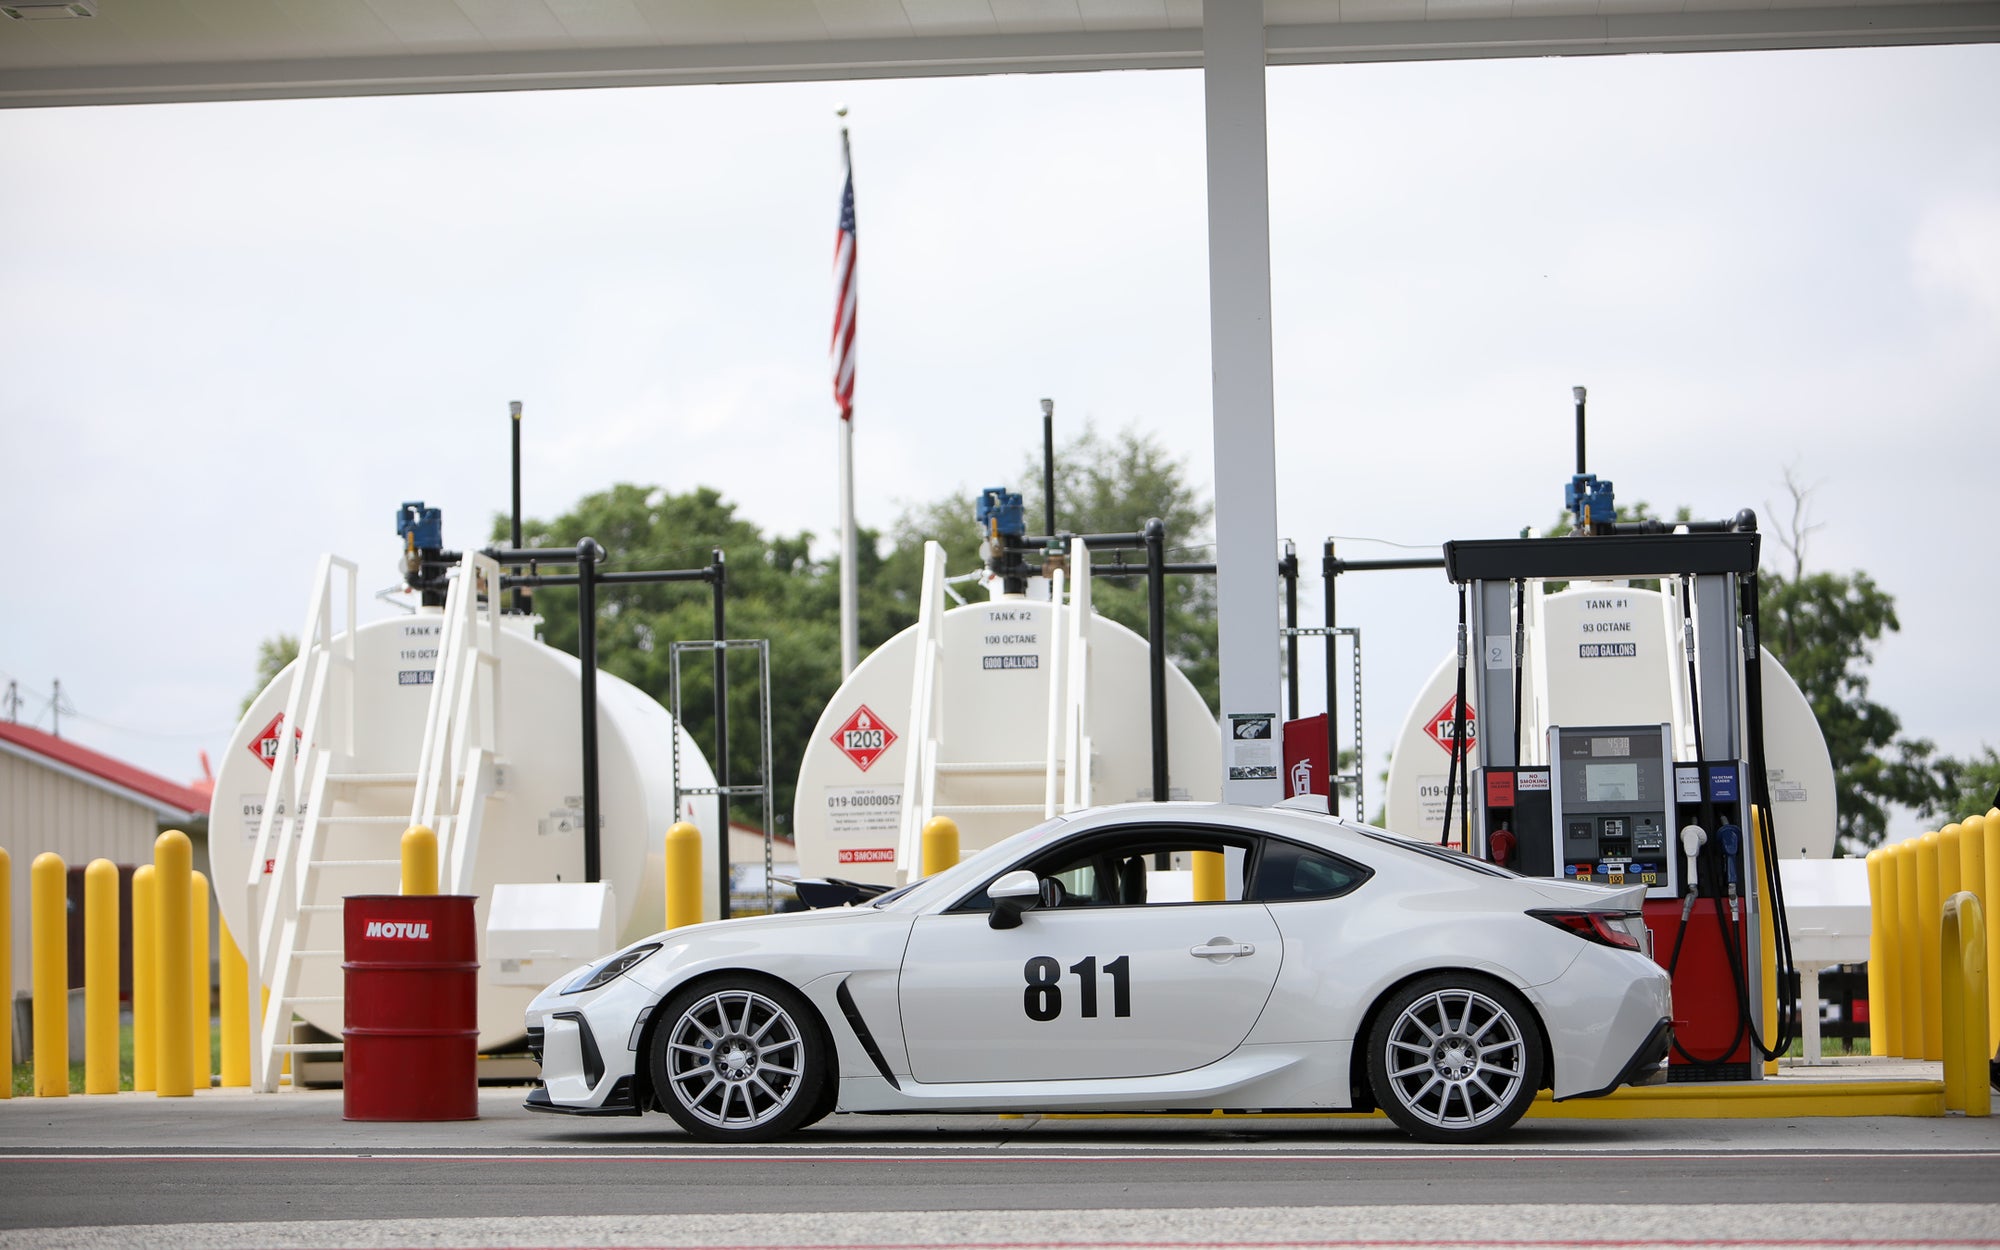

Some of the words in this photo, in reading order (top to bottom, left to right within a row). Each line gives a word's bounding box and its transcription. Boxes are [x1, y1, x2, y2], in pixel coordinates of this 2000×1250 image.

[1586, 600, 1612, 609] TANK
[1617, 599, 1627, 608] #1
[990, 612, 1015, 621] TANK
[1020, 612, 1031, 621] #2
[405, 627, 430, 636] TANK
[1583, 623, 1594, 633] 93
[1596, 622, 1631, 632] OCTANE
[984, 635, 1000, 645] 100
[1002, 634, 1037, 644] OCTANE
[400, 649, 416, 659] 110
[1491, 647, 1503, 662] 2
[1581, 645, 1599, 657] 6000
[1600, 643, 1635, 656] GALLONS
[1003, 655, 1037, 668] GALLONS
[1439, 720, 1476, 738] 123
[846, 730, 882, 748] 1203
[861, 755, 869, 767] 3
[840, 851, 852, 861] NO
[854, 850, 893, 860] SMOKING
[366, 922, 429, 939] MOTUL
[1024, 956, 1130, 1021] 811
